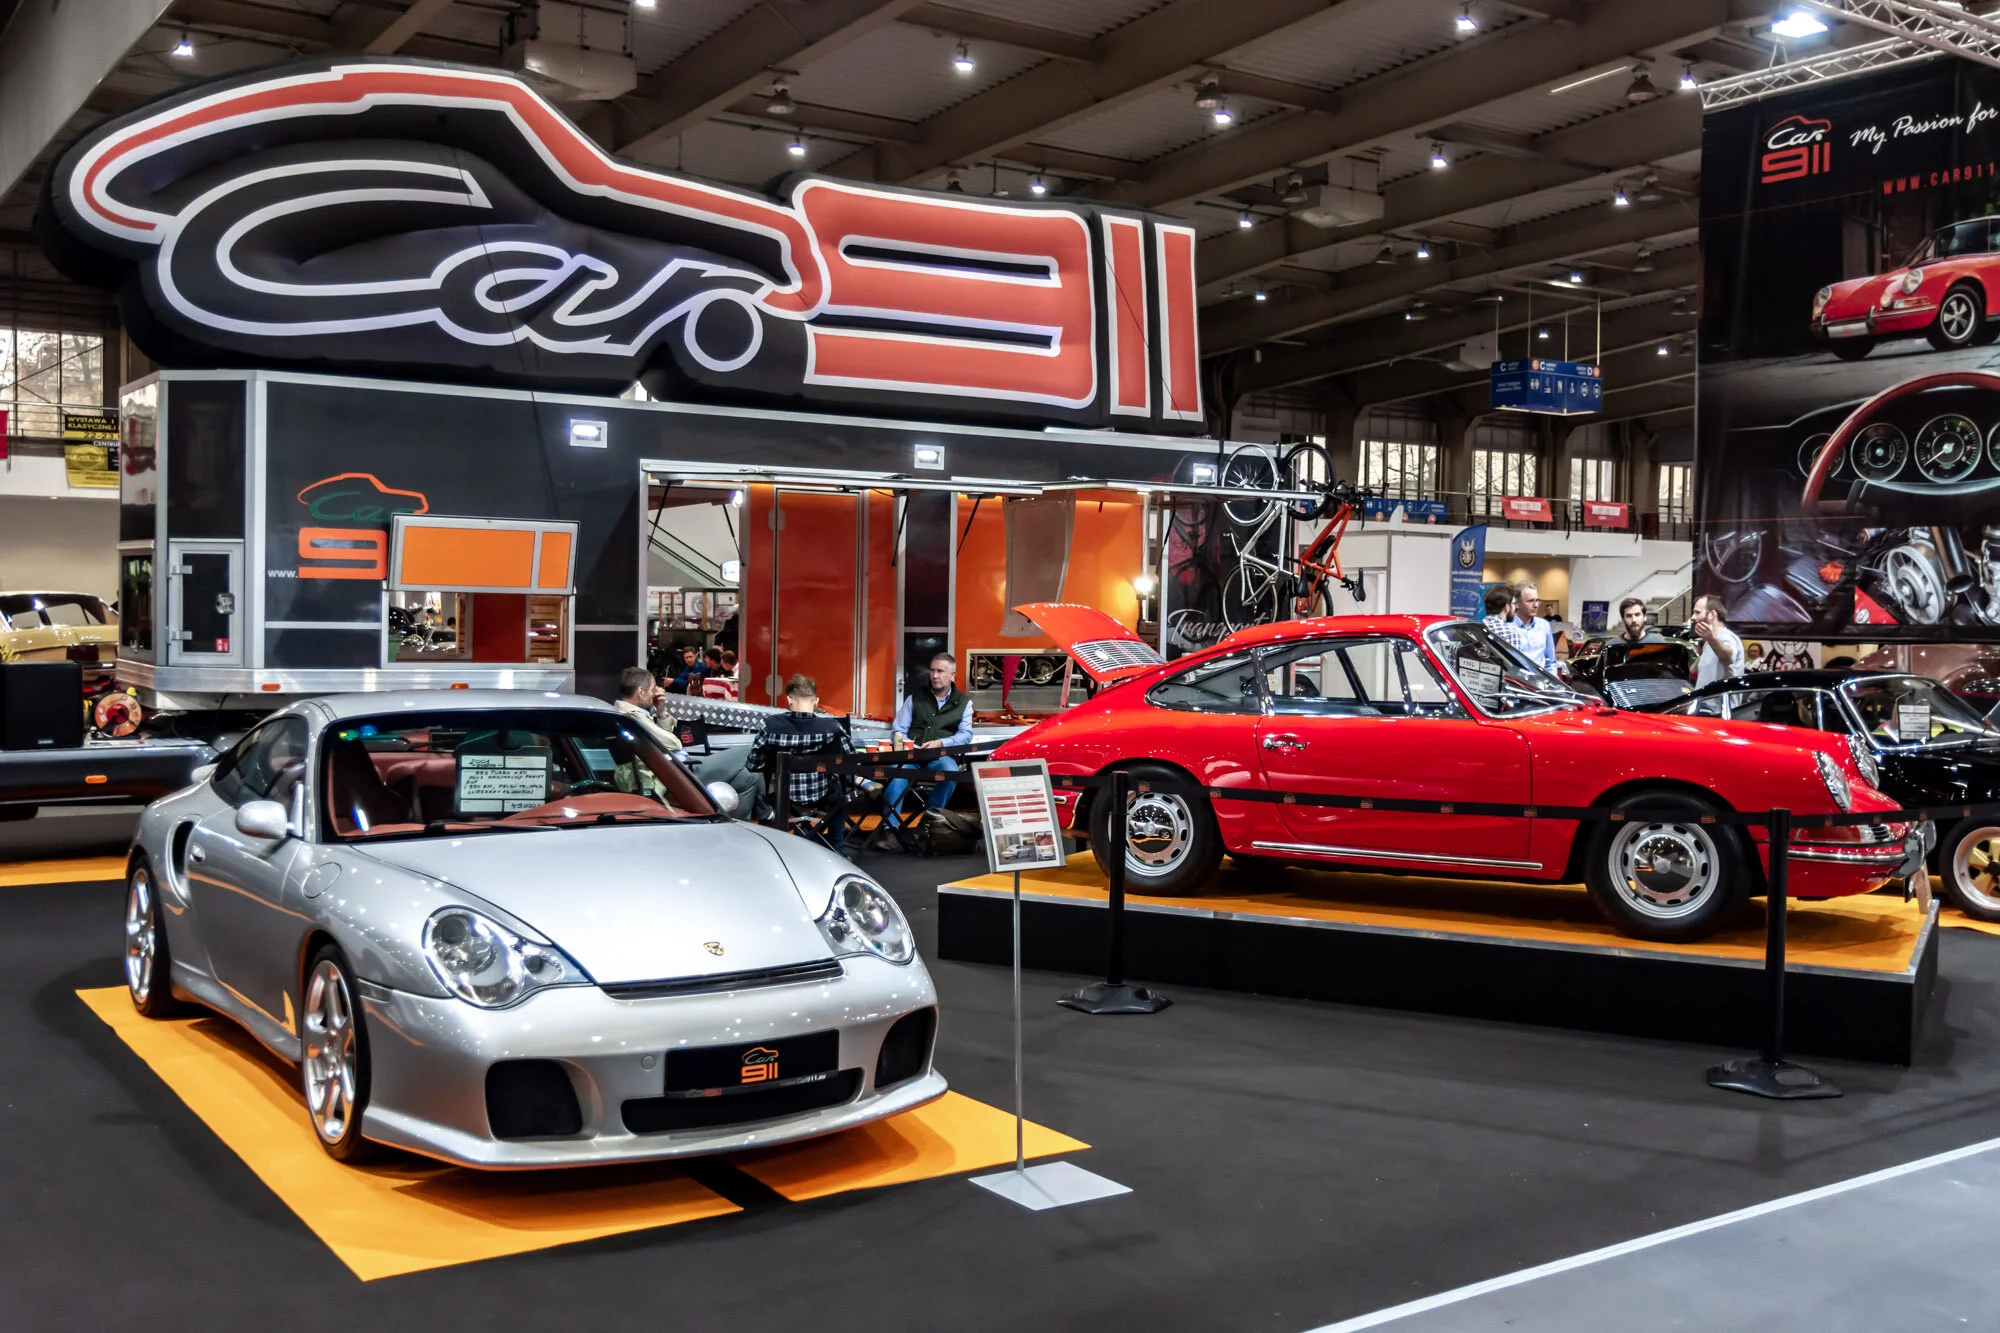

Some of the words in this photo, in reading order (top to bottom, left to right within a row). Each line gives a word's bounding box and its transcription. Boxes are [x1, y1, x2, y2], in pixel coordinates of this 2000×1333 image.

[1767, 127, 1825, 149] Car
[1850, 126, 1887, 154] My
[1893, 115, 1964, 138] Passion
[1966, 101, 1998, 134] for
[1761, 141, 1831, 184] 911
[158, 159, 772, 371] Car
[792, 179, 1204, 422] 911
[1539, 361, 1546, 370] C
[67, 416, 107, 424] WYSTAWA
[67, 423, 117, 431] KLASYCZNEJ
[267, 569, 298, 579] www.
[741, 1062, 779, 1084] 911
